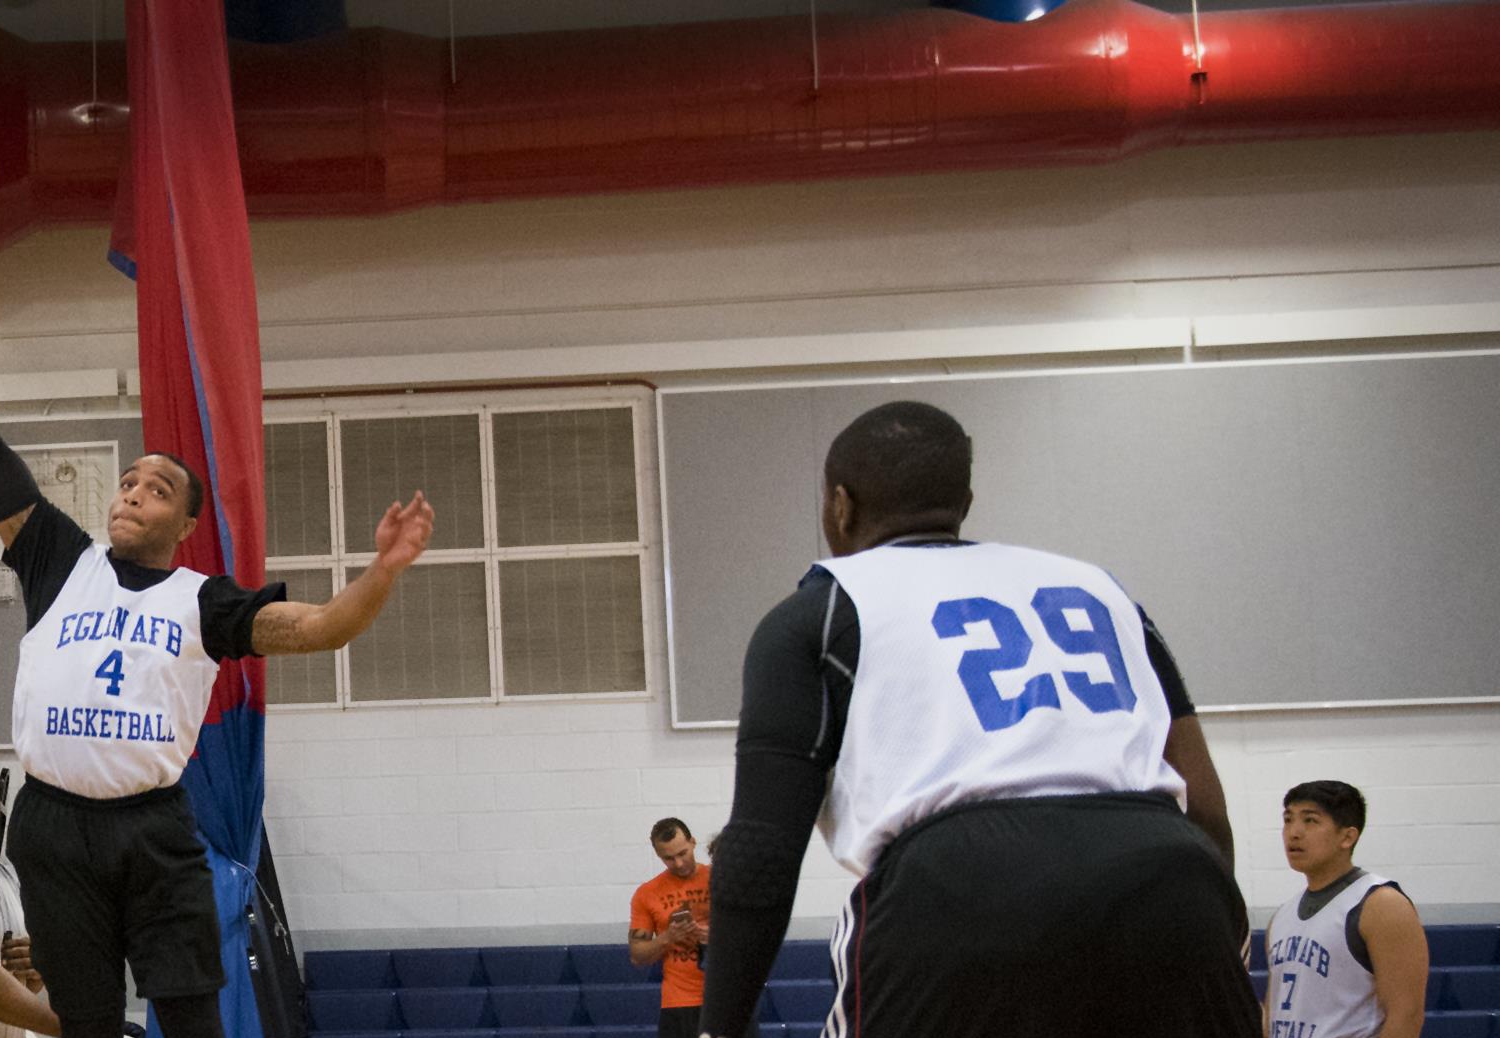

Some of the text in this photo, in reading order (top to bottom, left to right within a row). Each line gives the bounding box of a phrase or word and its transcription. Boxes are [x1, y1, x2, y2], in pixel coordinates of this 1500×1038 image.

[56, 606, 183, 658] EGLIN AFB
[94, 649, 125, 697] 4
[931, 586, 1138, 733] 29
[46, 706, 176, 743] BASKETBALL
[1281, 973, 1297, 1010] 7
